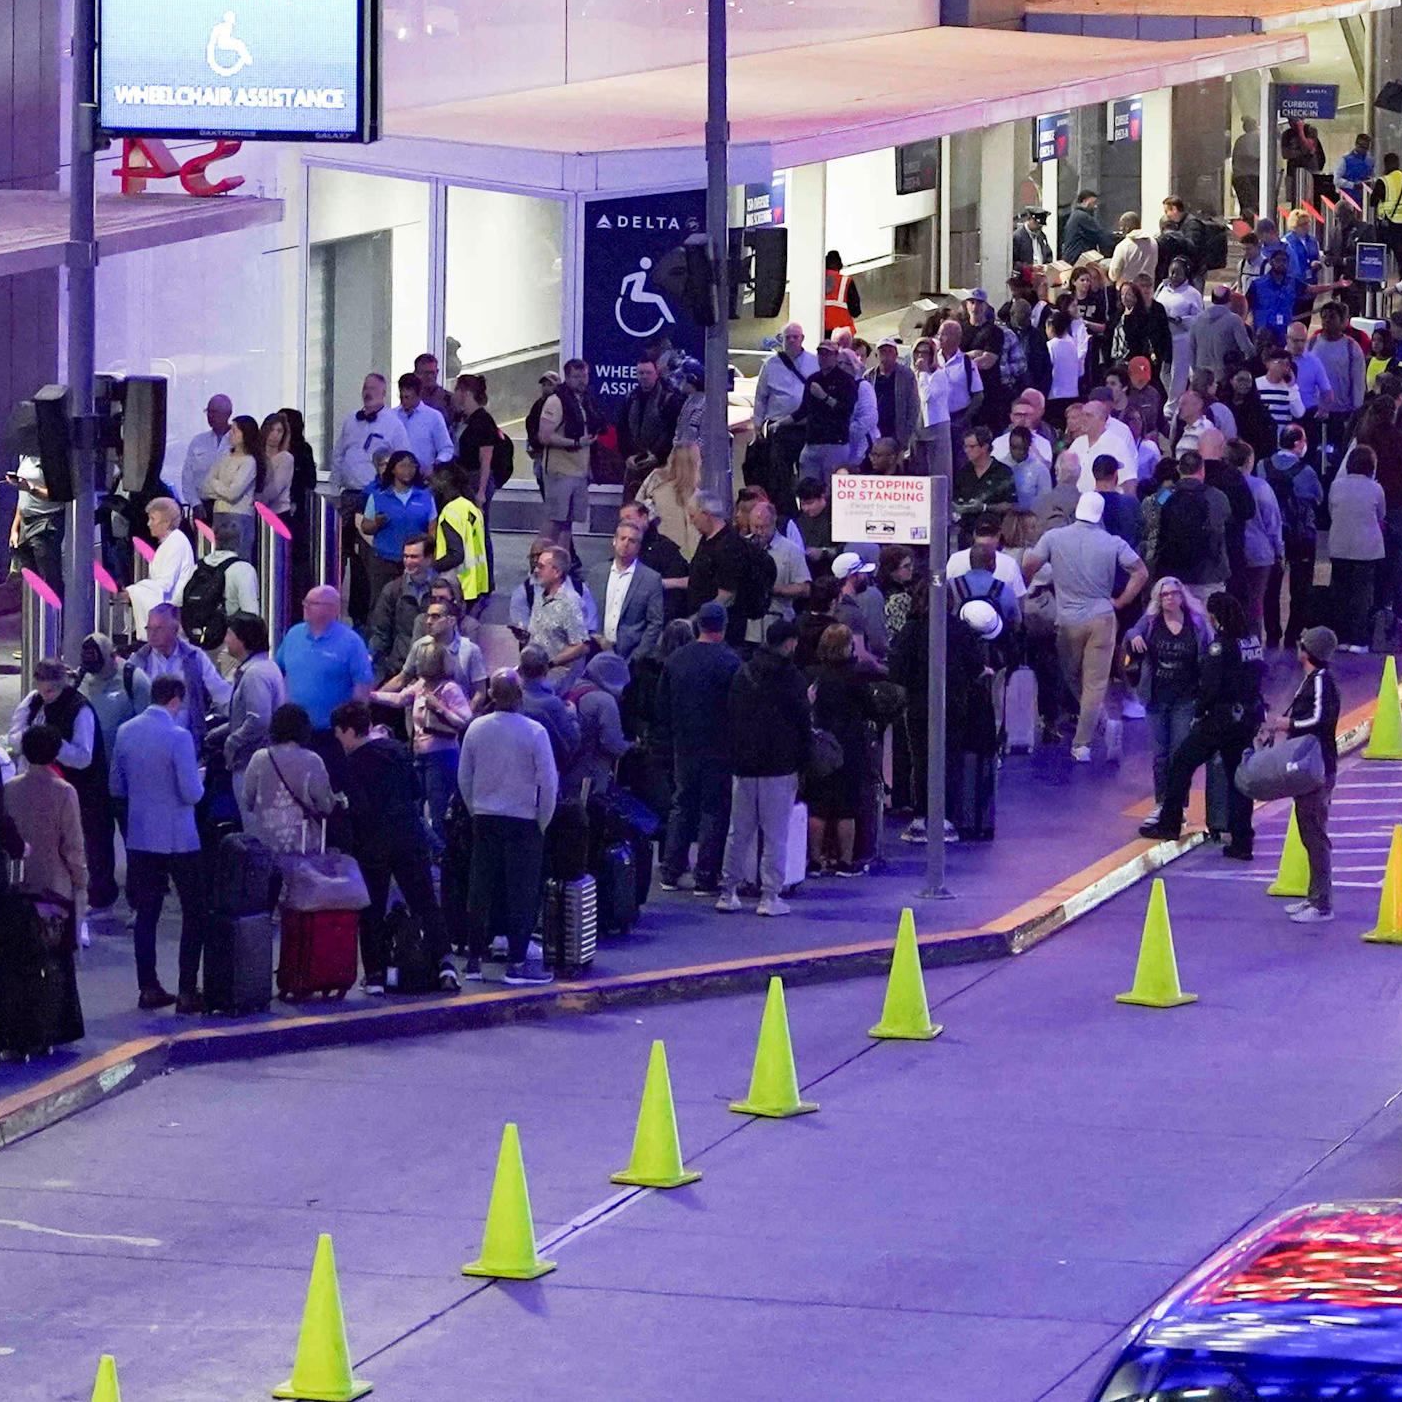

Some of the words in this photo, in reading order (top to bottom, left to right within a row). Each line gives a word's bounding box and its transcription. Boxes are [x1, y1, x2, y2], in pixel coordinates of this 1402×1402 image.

[115, 85, 233, 107] WHEELCHAIR
[235, 86, 345, 109] ASSISTANCE
[1282, 100, 1319, 109] CURBSIDE
[617, 214, 680, 231] DELTA
[838, 479, 856, 489] NO
[860, 479, 924, 491] STOPPING
[837, 491, 855, 500] OR
[860, 491, 925, 502] STANDING
